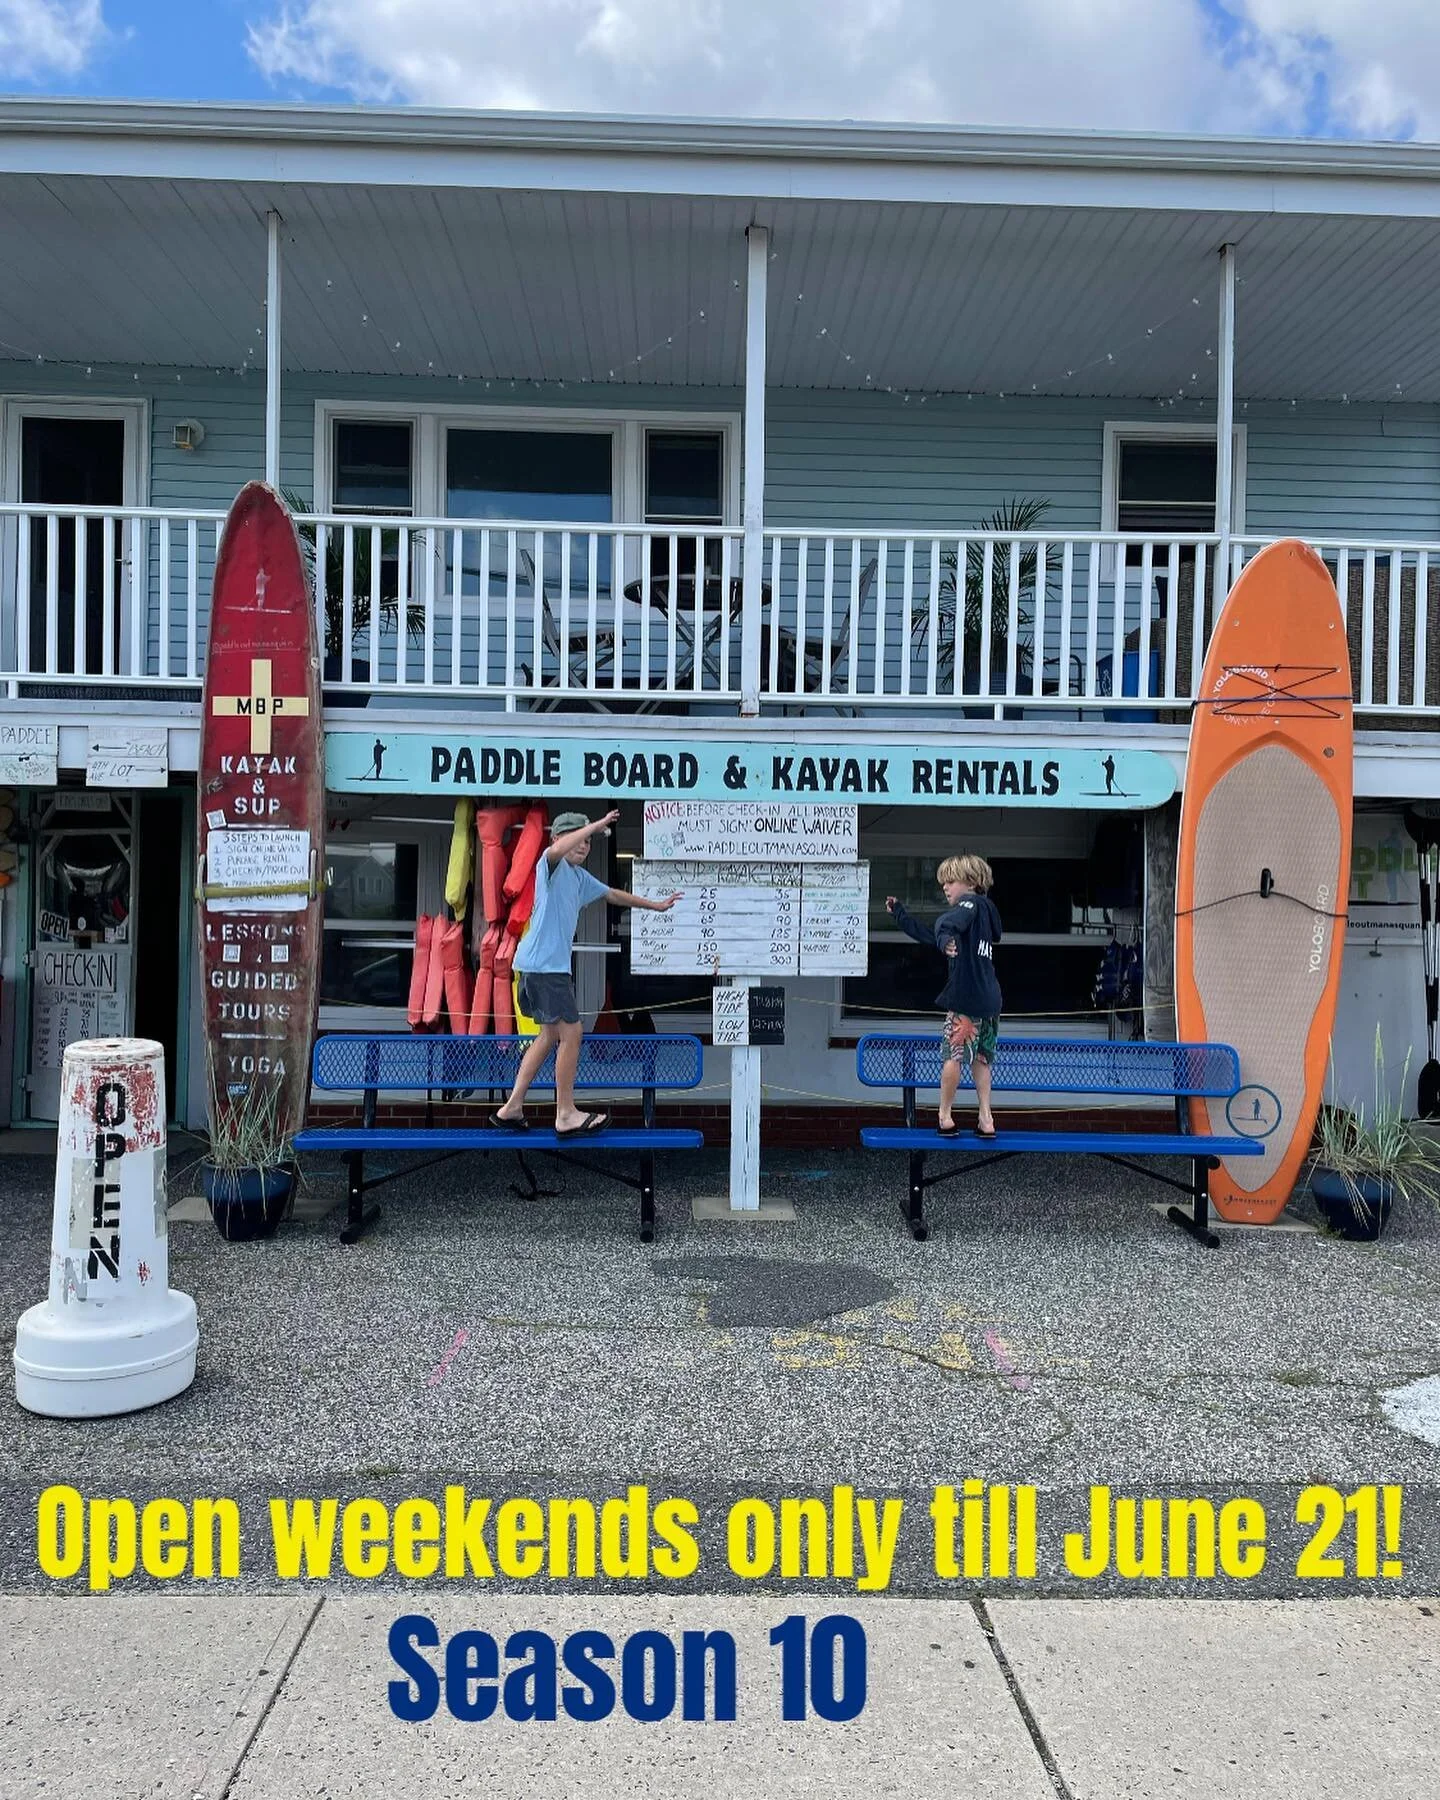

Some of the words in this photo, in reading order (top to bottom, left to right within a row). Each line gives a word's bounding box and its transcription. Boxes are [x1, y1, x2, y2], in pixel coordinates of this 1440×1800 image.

[110, 763, 136, 777] LOT
[221, 756, 297, 774] KAYAK
[430, 746, 561, 785] PADDLE
[584, 752, 699, 789] BOARD
[723, 755, 747, 790] &
[771, 756, 889, 793] KAYAK
[912, 759, 1059, 796] RENTALS
[252, 777, 265, 795] &
[234, 797, 281, 815] SUP
[686, 803, 723, 817] BEFORE
[727, 803, 780, 817] CHECK-IN
[788, 805, 808, 817] ALL
[814, 806, 856, 818] PADDLERS
[678, 819, 711, 833] MUST
[754, 818, 798, 834] ONLINE
[802, 819, 853, 836] WAIVER
[700, 887, 718, 900] 25
[775, 888, 792, 900] 35
[699, 901, 717, 912] 50
[777, 902, 791, 912] 70
[41, 912, 69, 940] OPEN
[700, 914, 716, 925] 65
[776, 915, 792, 926] 90
[847, 915, 861, 926] 70
[700, 928, 715, 938] 90
[771, 928, 792, 939] 125
[696, 942, 718, 952] 150
[770, 942, 791, 953] 200
[696, 953, 715, 966] 250
[44, 952, 114, 988] CHECK-IN
[211, 970, 298, 991] GUIDED
[716, 990, 746, 1002] HIGH
[218, 1002, 291, 1021] TOURS
[717, 1002, 744, 1014] TIDE
[718, 1019, 744, 1030] LOW
[717, 1031, 743, 1042] TIDE
[228, 1055, 287, 1075] YOGA
[87, 1082, 126, 1280] OPEN
